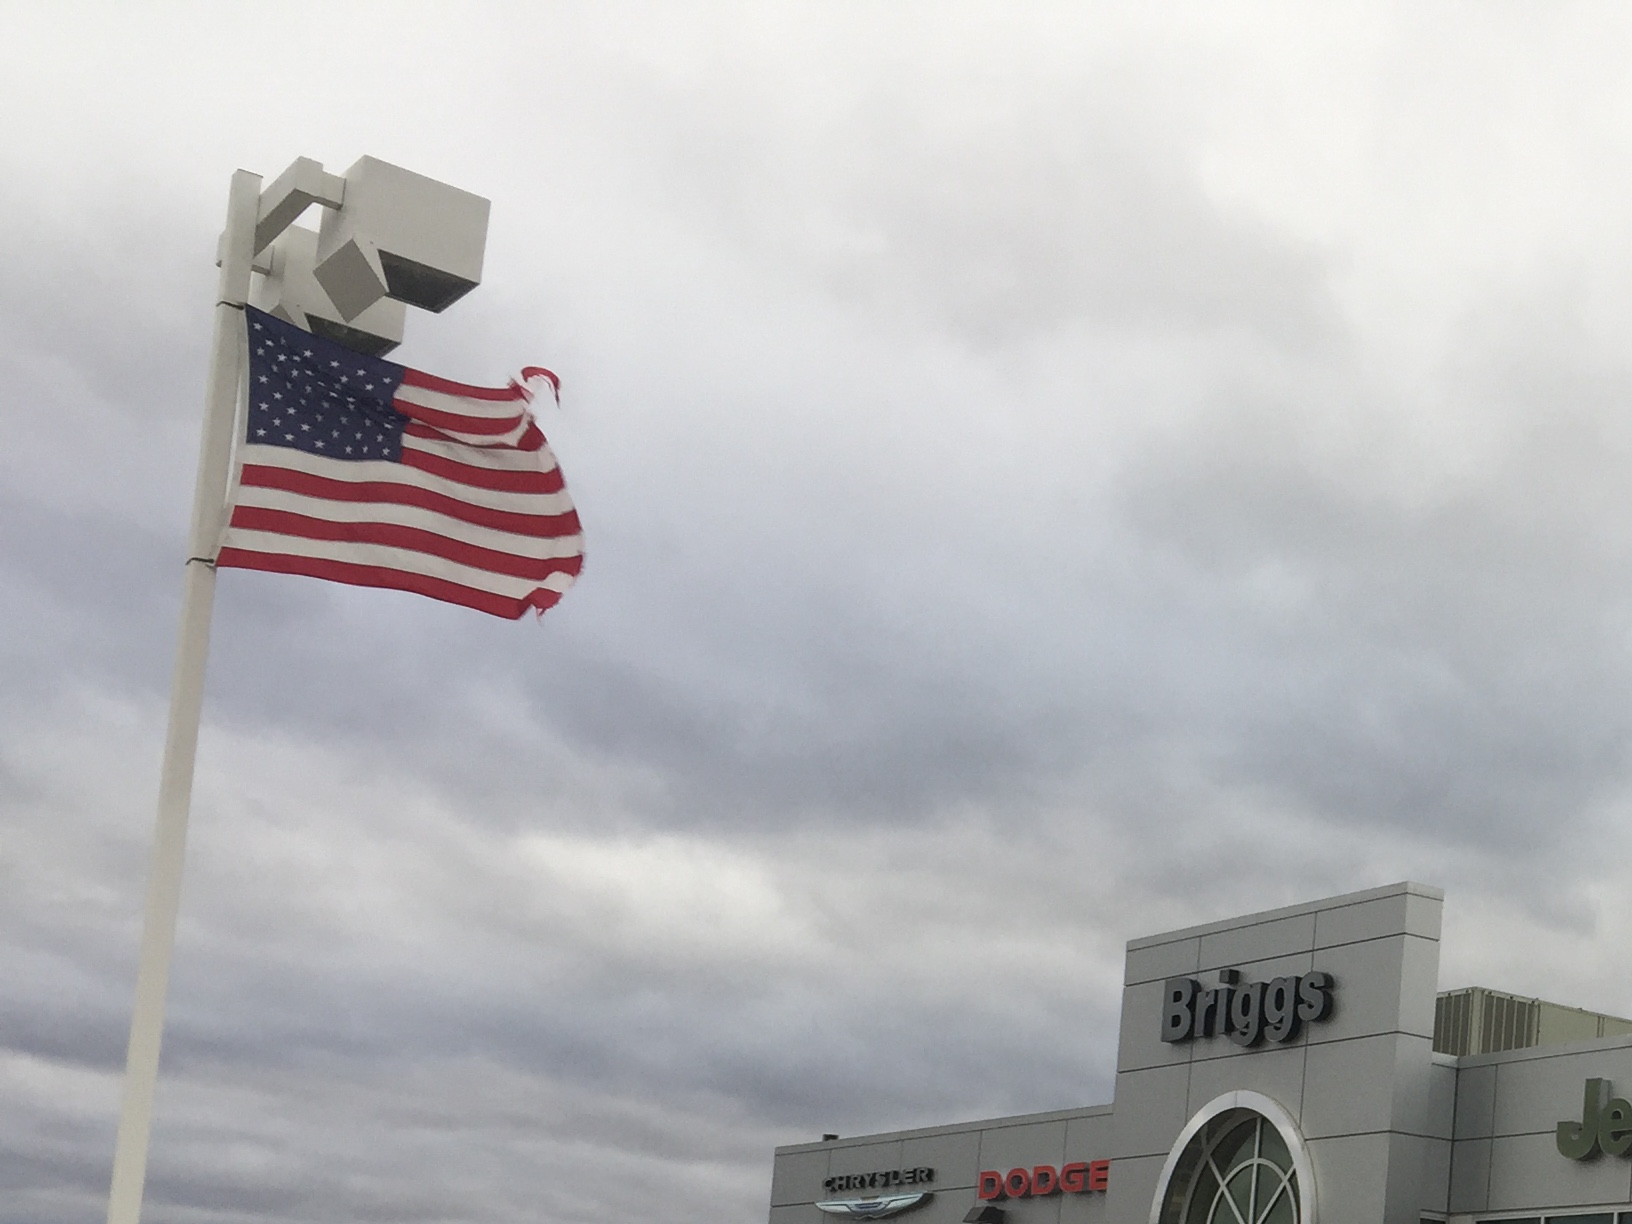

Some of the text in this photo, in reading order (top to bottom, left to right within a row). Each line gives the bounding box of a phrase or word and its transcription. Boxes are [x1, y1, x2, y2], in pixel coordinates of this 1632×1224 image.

[1161, 968, 1334, 1047] Briggs
[822, 1166, 936, 1192] CHRYSLER
[977, 1159, 1112, 1200] DODGE
